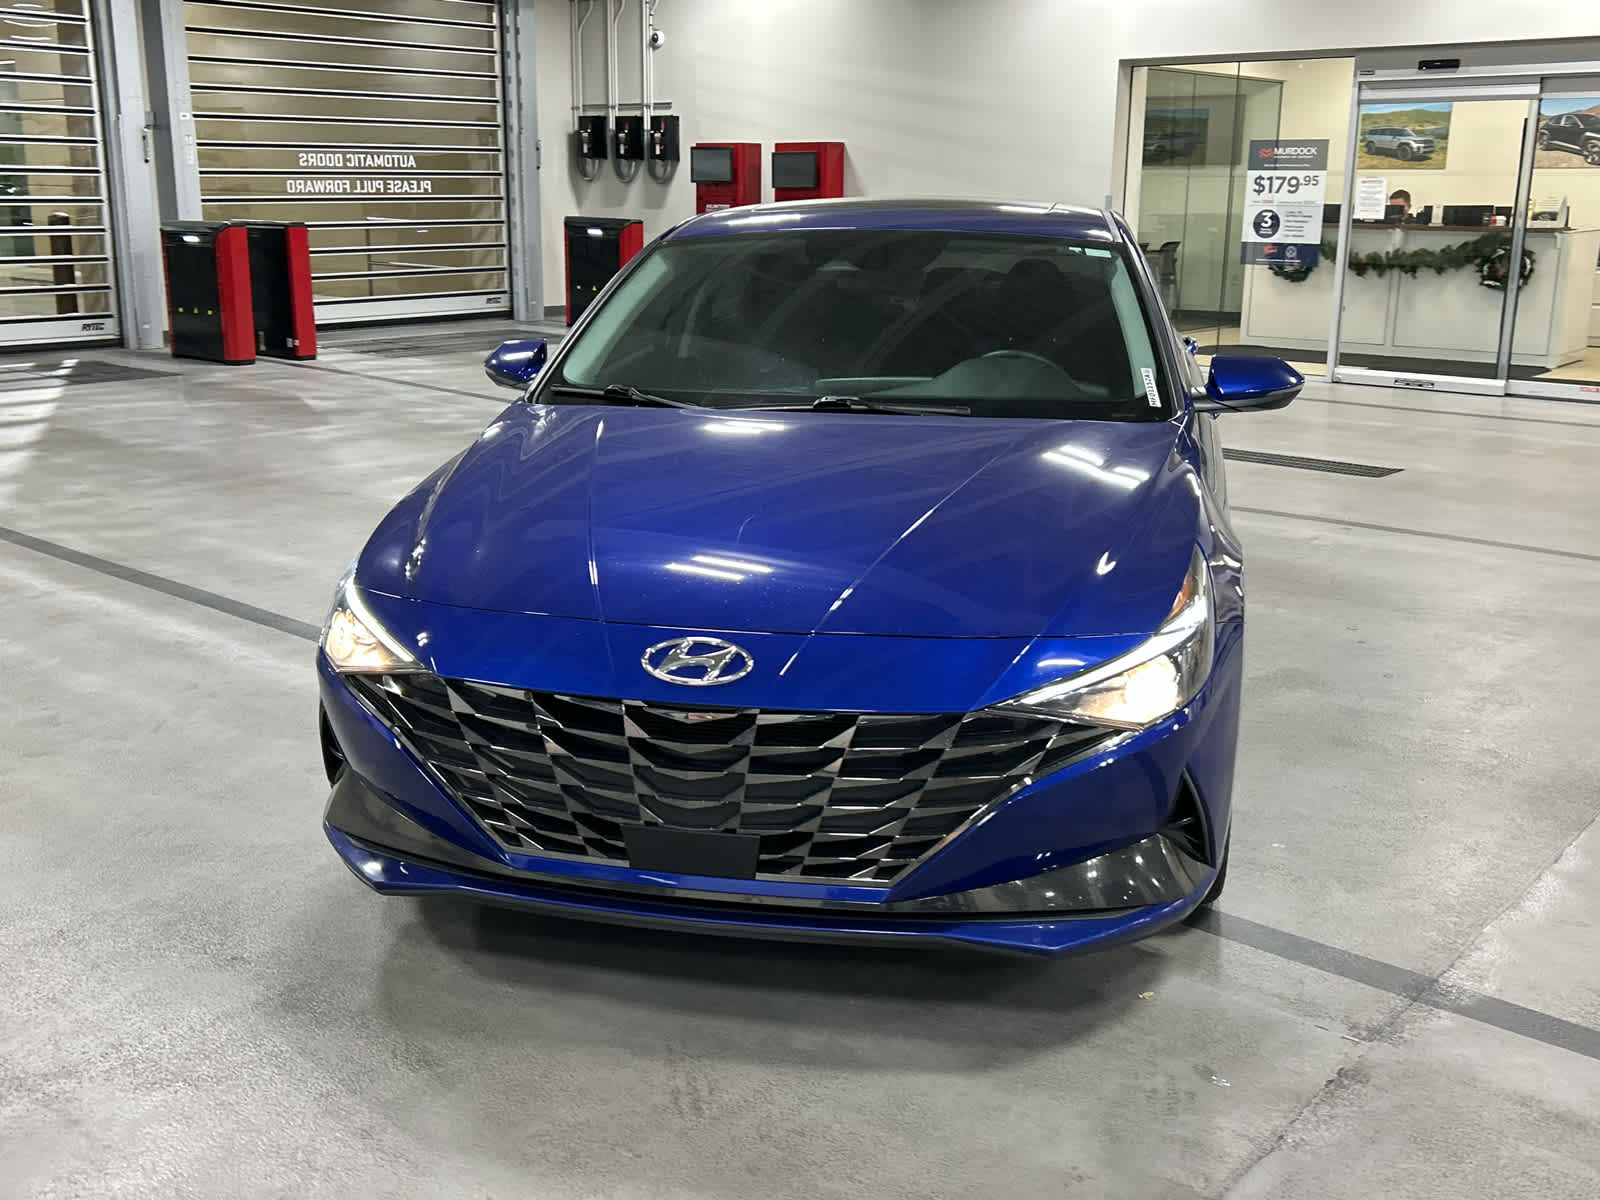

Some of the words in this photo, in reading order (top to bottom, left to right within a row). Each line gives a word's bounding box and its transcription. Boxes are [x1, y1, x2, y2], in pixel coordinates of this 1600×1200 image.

[1273, 147, 1318, 155] MURDOCK
[1253, 174, 1319, 196] $179.95
[1260, 212, 1273, 228] 3
